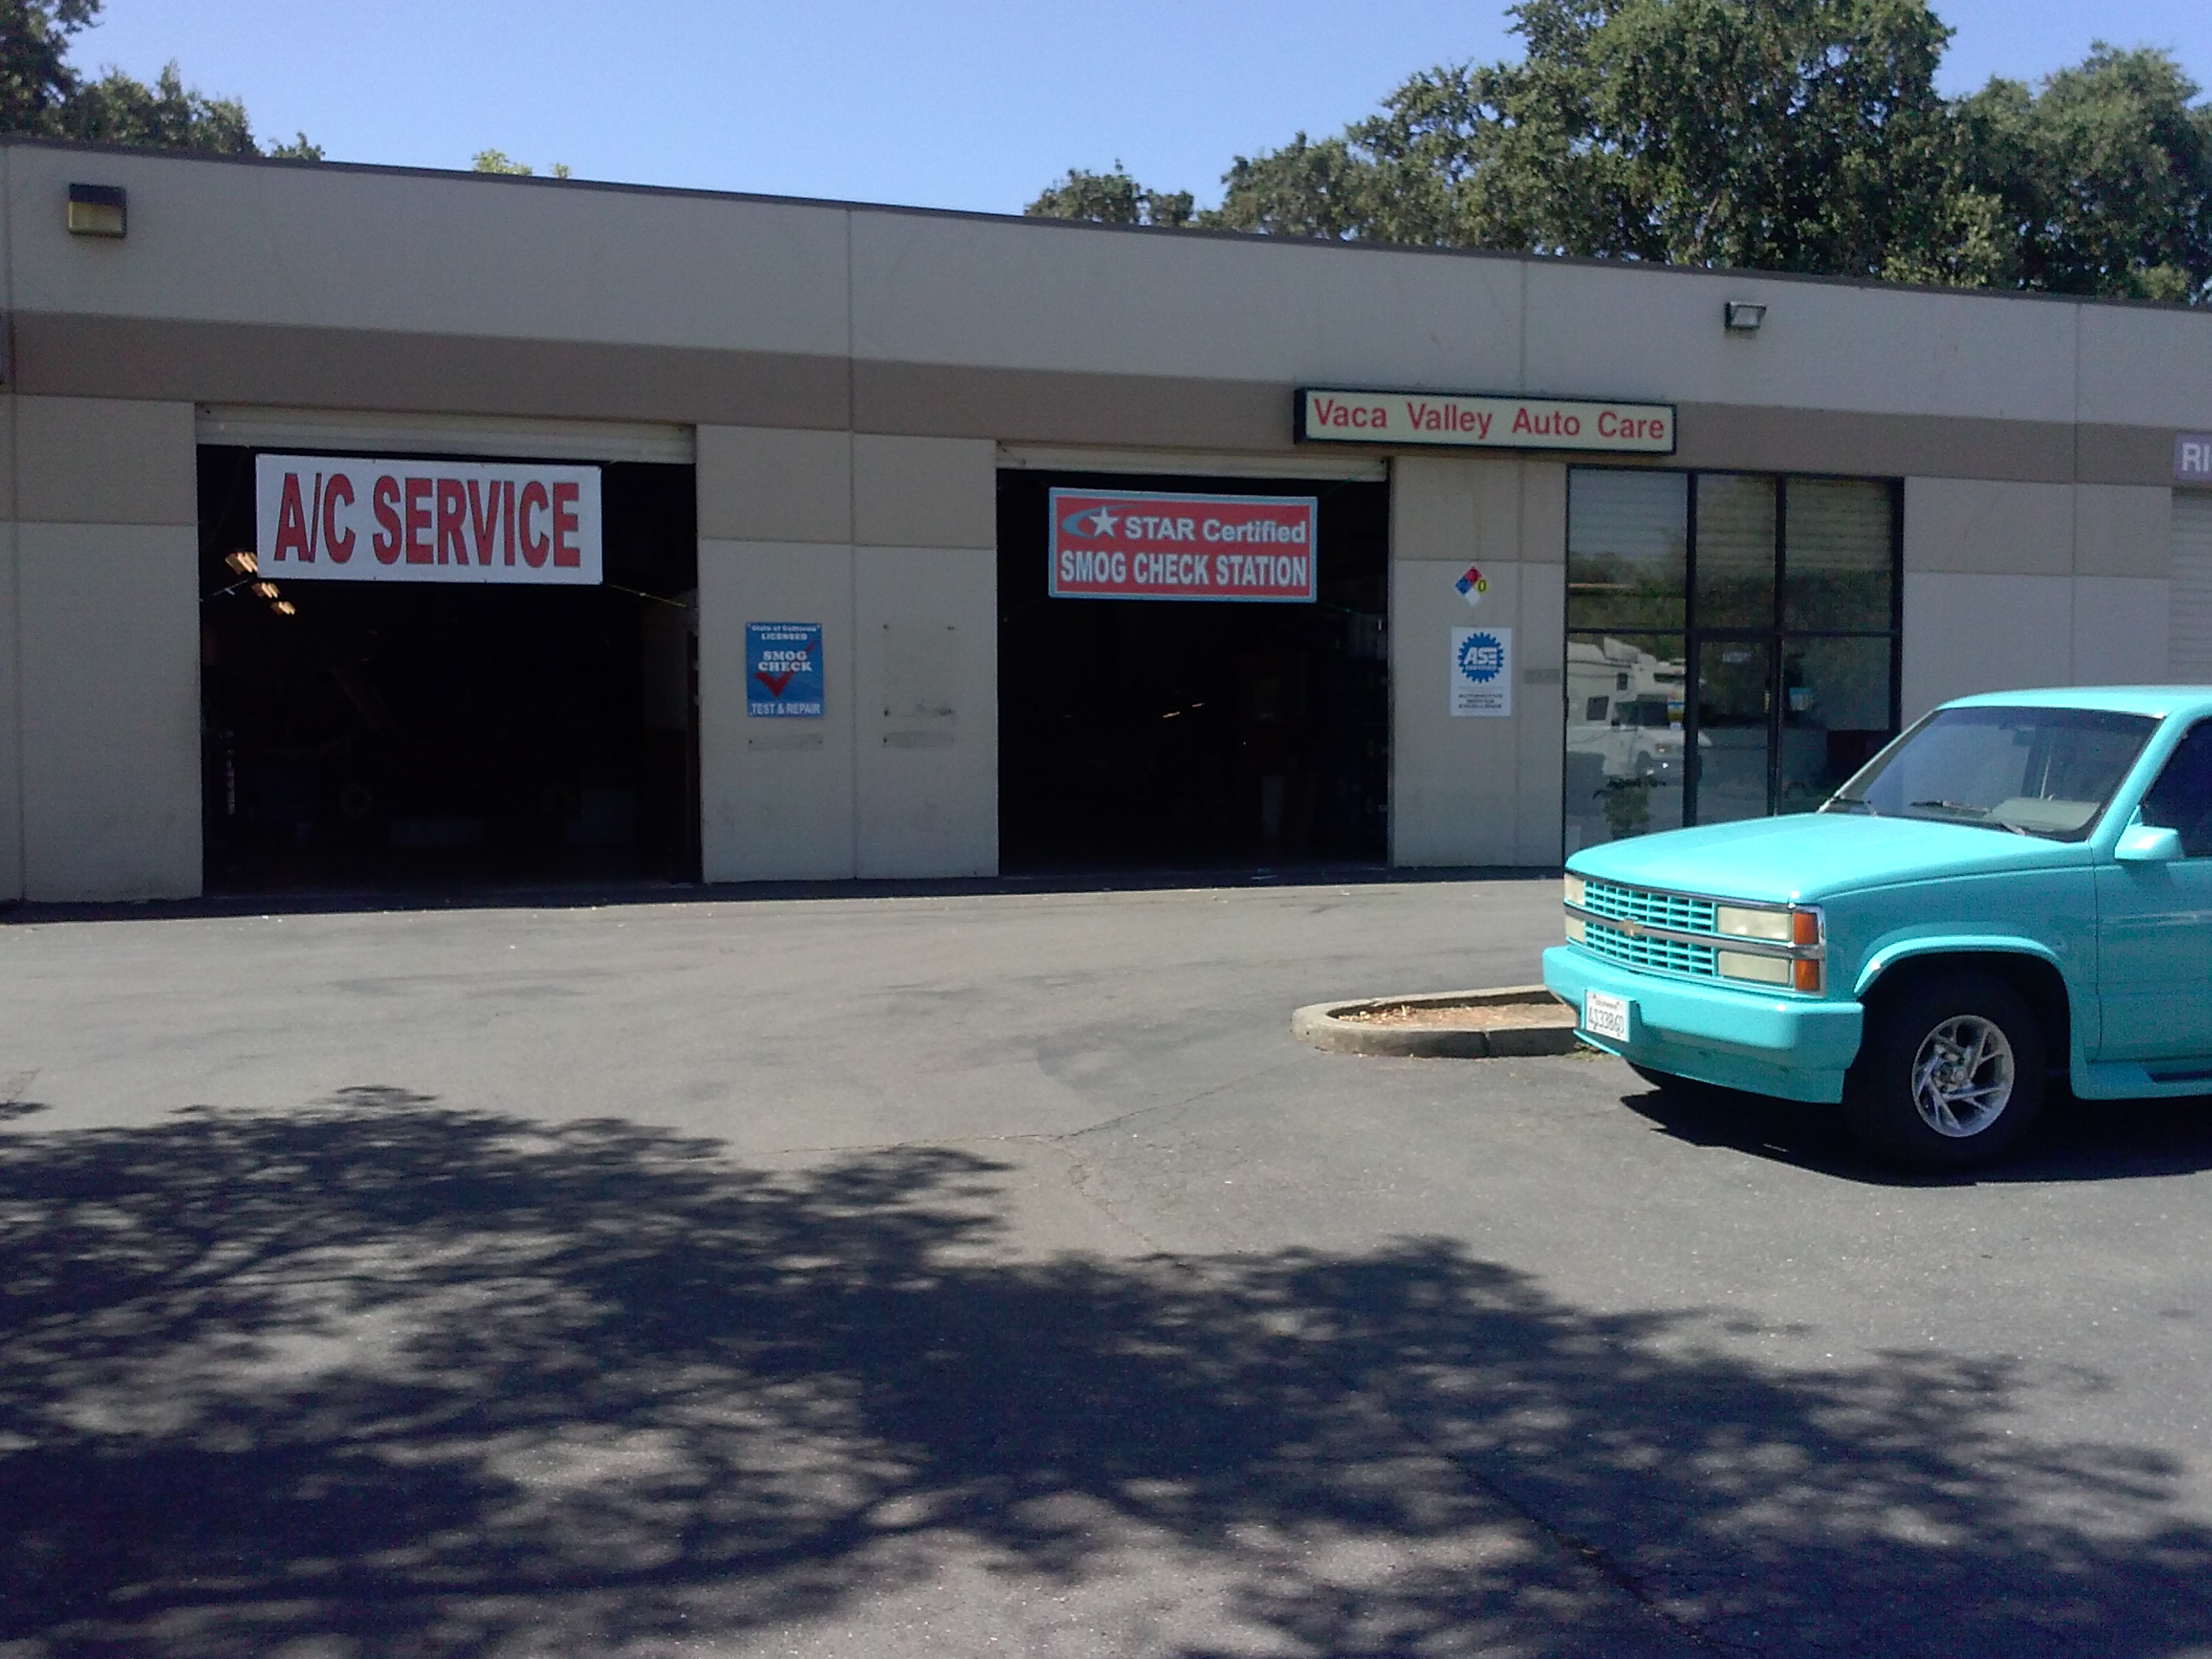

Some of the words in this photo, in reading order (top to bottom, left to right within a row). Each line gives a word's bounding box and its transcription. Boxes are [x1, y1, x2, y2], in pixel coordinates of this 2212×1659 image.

[1313, 397, 1388, 429] Vaca
[1406, 401, 1493, 440] Valley
[1511, 407, 1580, 437] Auto
[1597, 410, 1665, 440] Care
[2182, 442, 2212, 472] RI
[273, 472, 356, 564] A/C
[372, 474, 582, 569] SERVICE
[1125, 516, 1195, 540] STAR
[1202, 519, 1307, 544] Certified
[1060, 550, 1126, 584] SMOG
[1132, 552, 1209, 585] CHECK
[1216, 555, 1307, 587] STATION
[761, 632, 807, 641] LICENSED
[758, 661, 812, 672] CHECK
[763, 650, 807, 661] SMOG
[1463, 647, 1498, 665] ASE
[752, 703, 775, 714] TEST
[777, 703, 784, 714] &
[787, 703, 820, 714] REPAIR
